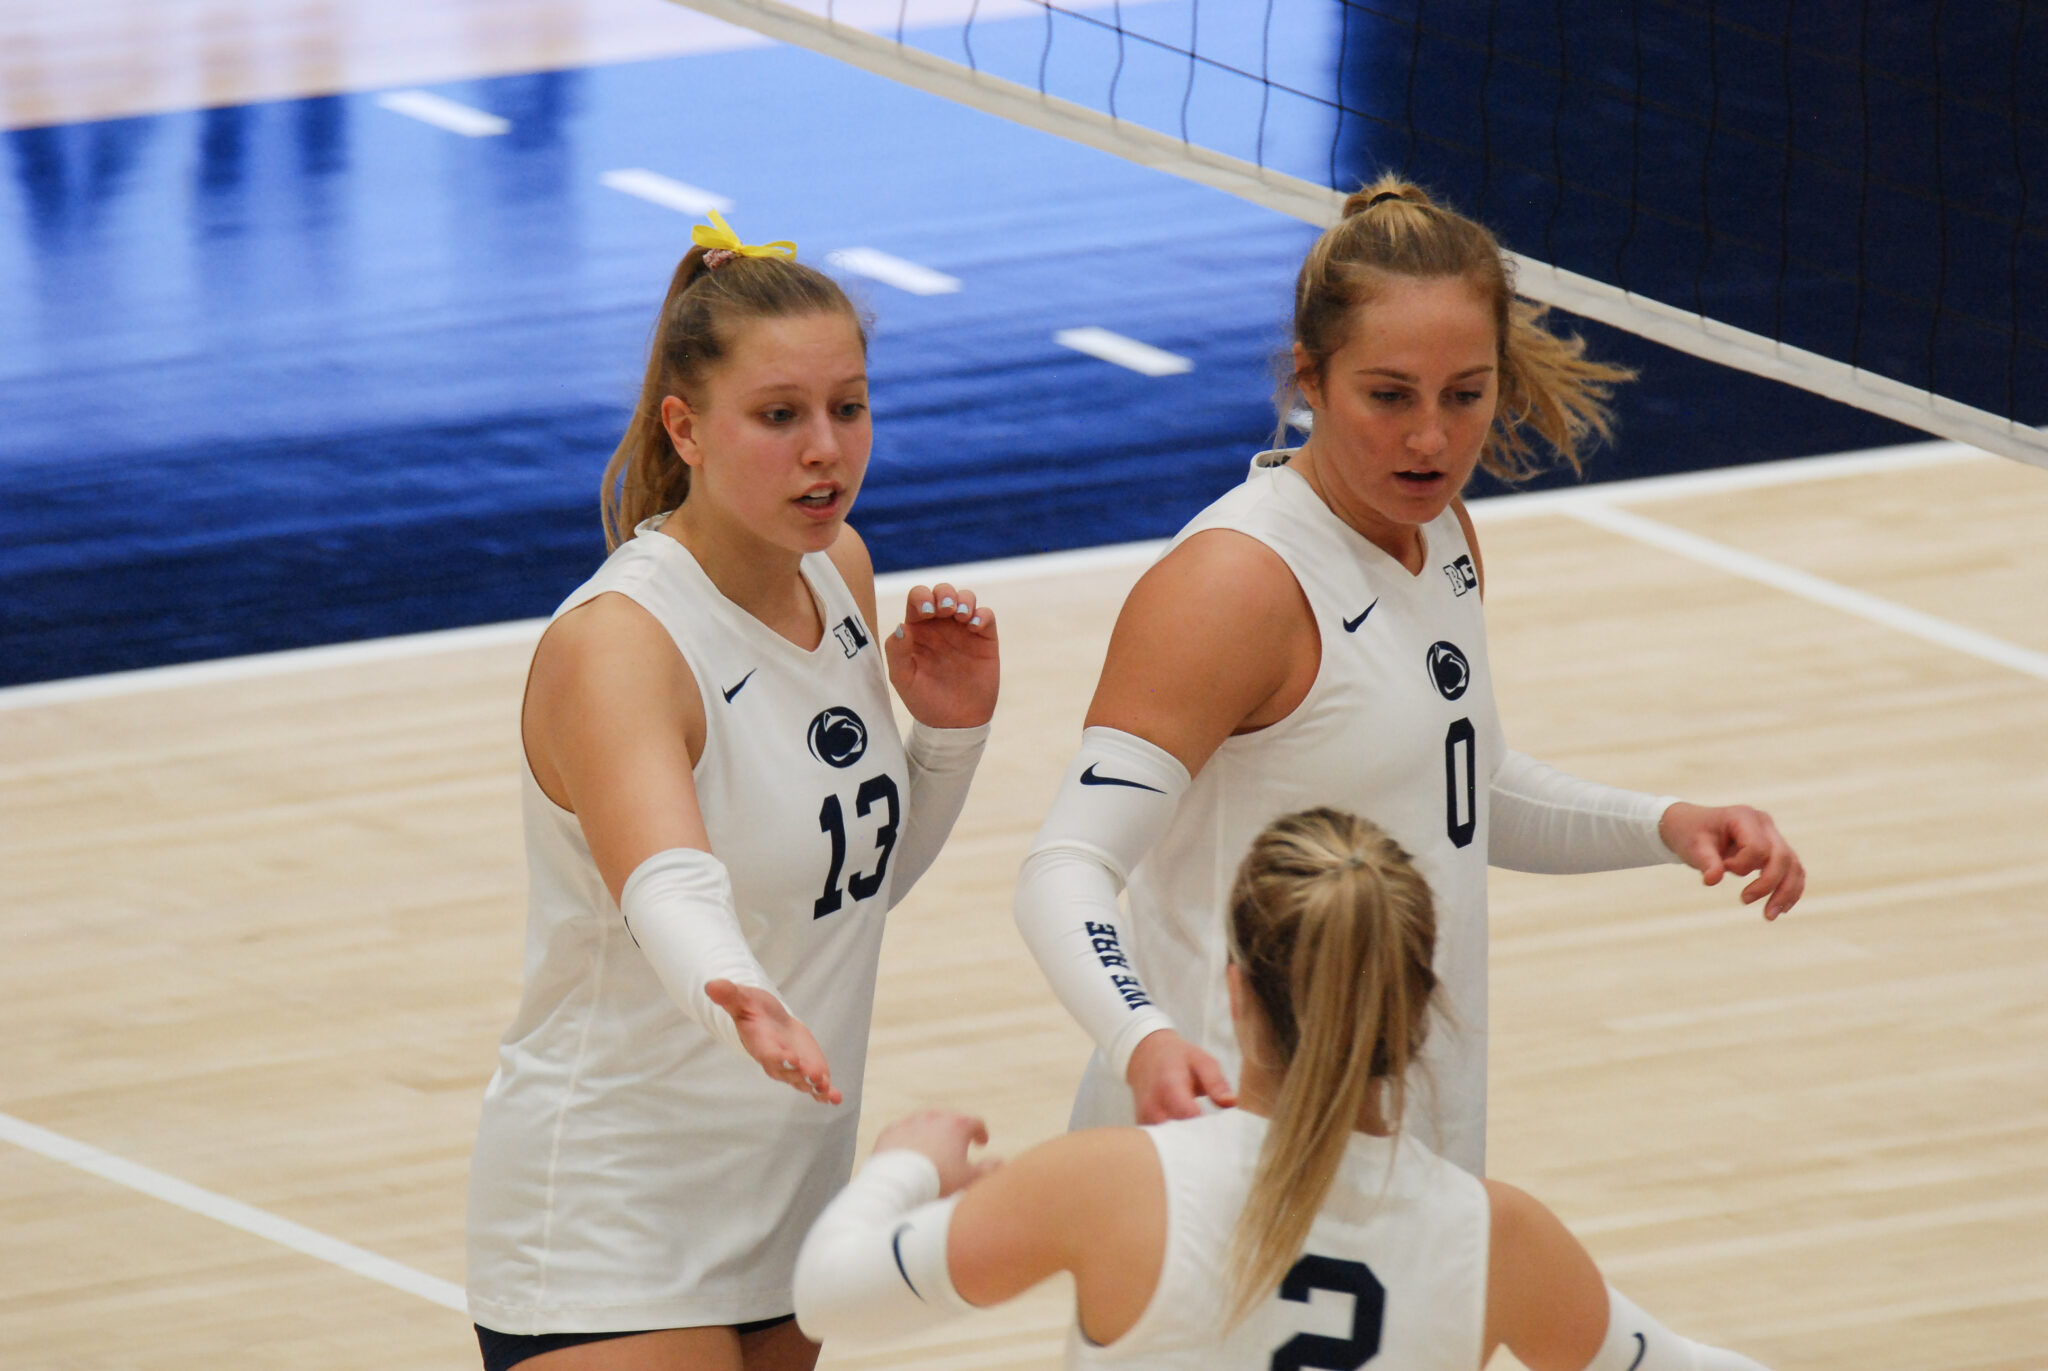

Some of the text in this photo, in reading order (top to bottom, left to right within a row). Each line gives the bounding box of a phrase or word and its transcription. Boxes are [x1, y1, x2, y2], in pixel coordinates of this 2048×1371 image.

[1445, 716, 1476, 849] 0
[813, 773, 900, 920] 13
[1084, 921, 1153, 1010] WE ARE
[1270, 1253, 1385, 1371] 2
